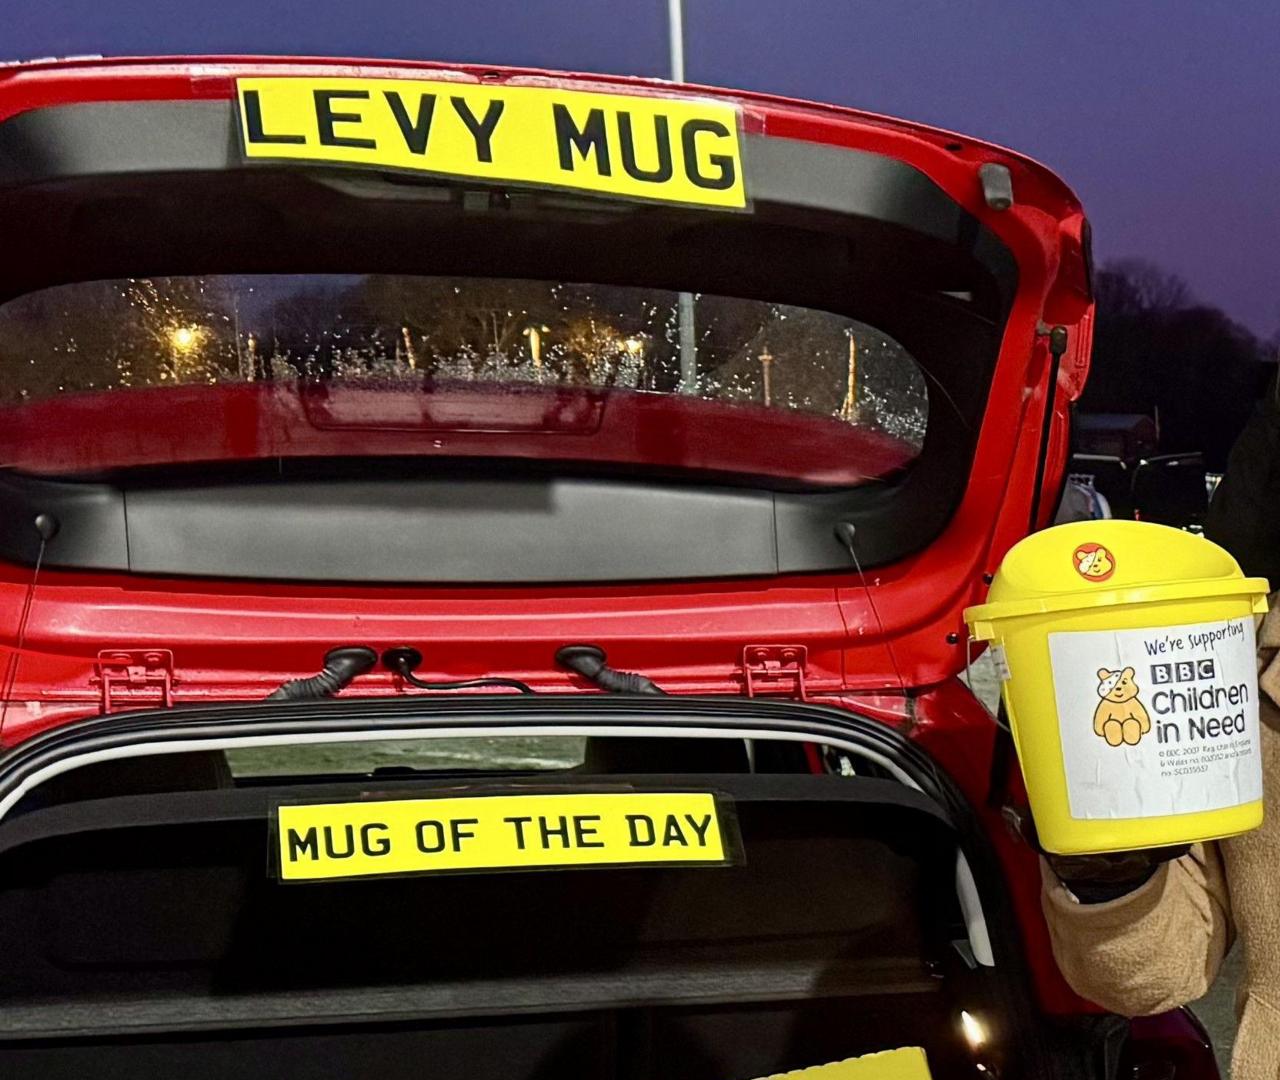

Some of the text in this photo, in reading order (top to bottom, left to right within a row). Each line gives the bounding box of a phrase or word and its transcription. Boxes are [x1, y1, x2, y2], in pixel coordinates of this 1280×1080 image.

[243, 89, 737, 191] LEVY MUG
[1144, 635, 1184, 656] We're
[1151, 659, 1215, 684] BBC
[1152, 683, 1249, 715] Children
[1156, 708, 1245, 744] in Need
[288, 814, 712, 862] MUG OF THE DAY
